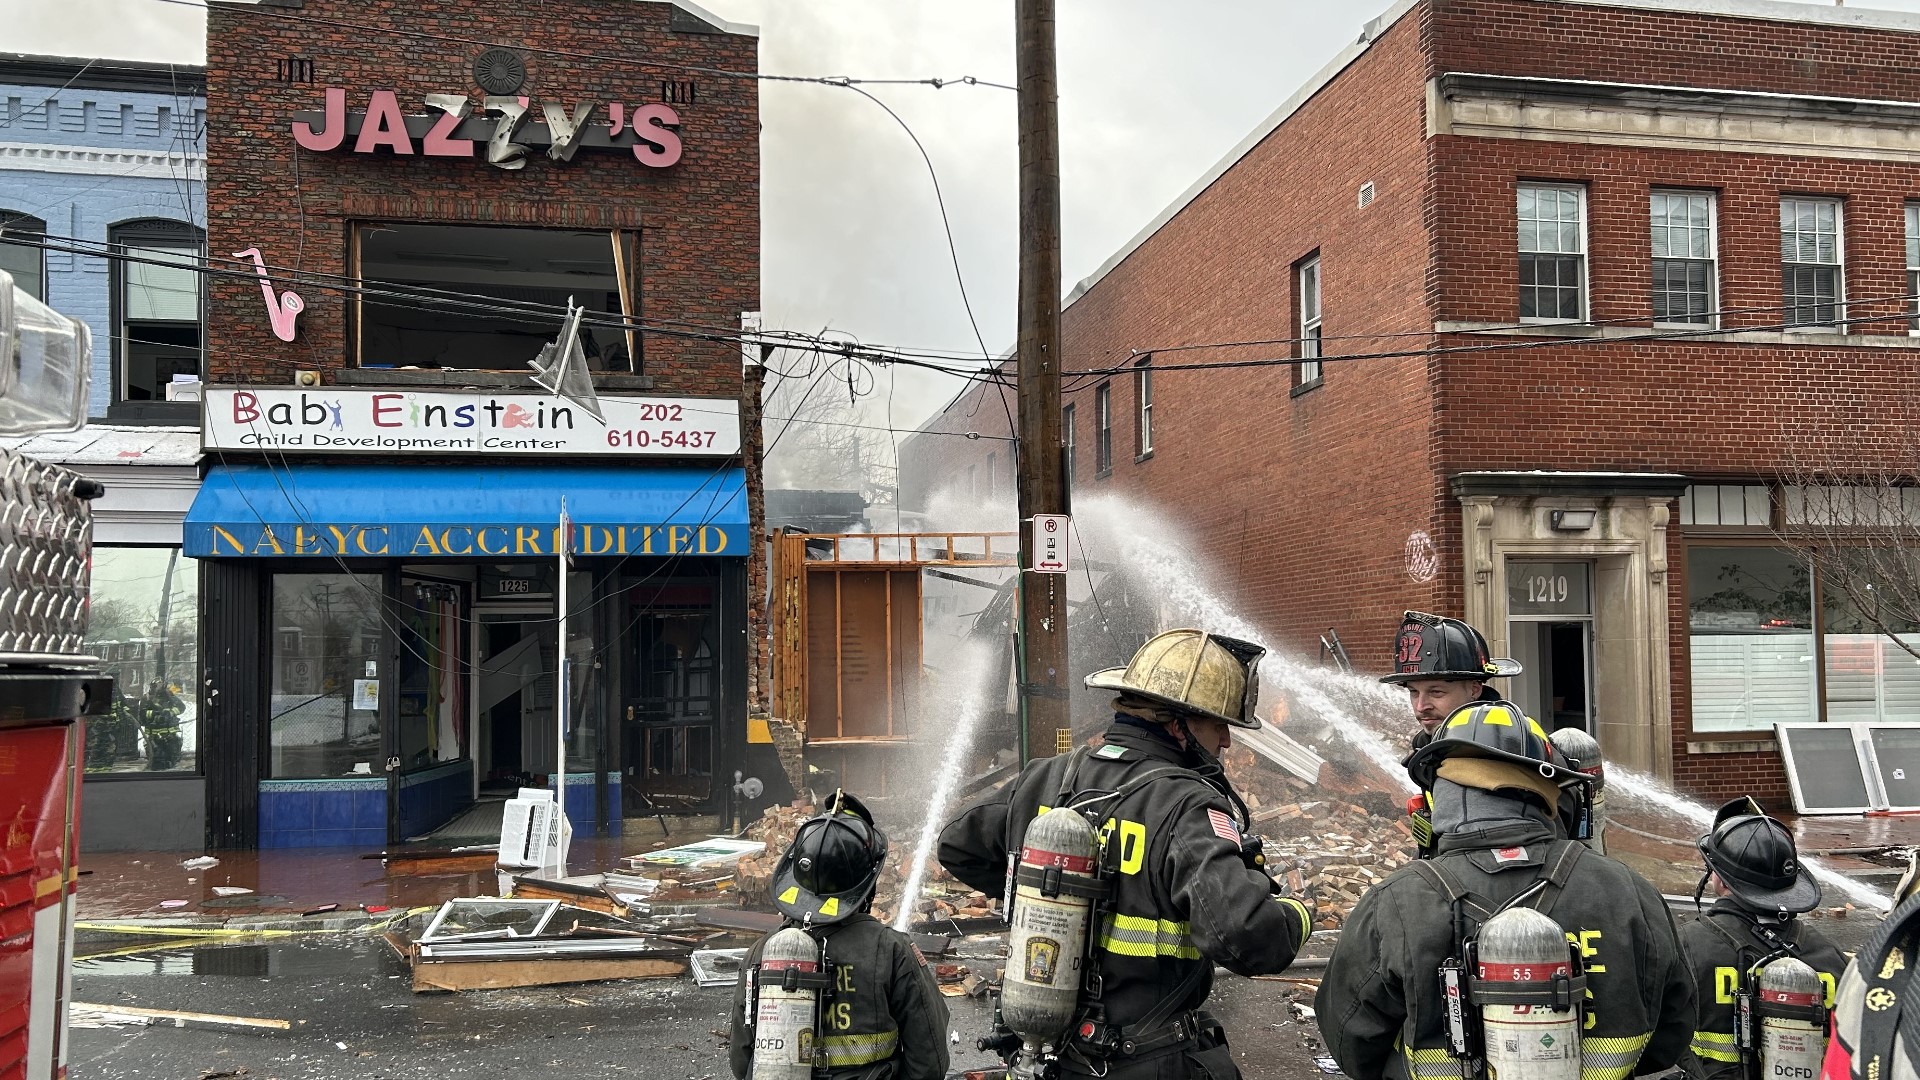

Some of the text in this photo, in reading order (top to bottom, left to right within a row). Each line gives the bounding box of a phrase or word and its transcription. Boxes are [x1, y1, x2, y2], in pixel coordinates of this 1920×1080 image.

[292, 87, 682, 169] JAZZY'S
[640, 404, 683, 421] 202
[240, 433, 566, 449] Child Development Center
[607, 430, 717, 448] 610-5437
[210, 525, 389, 555] NAEYC
[501, 580, 528, 592] 1225
[1527, 575, 1568, 602] 1219
[1399, 634, 1422, 662] 32
[1513, 968, 1532, 981] 5.5
[1452, 998, 1461, 1025] SCOTT
[1774, 1064, 1813, 1079] DCFD
